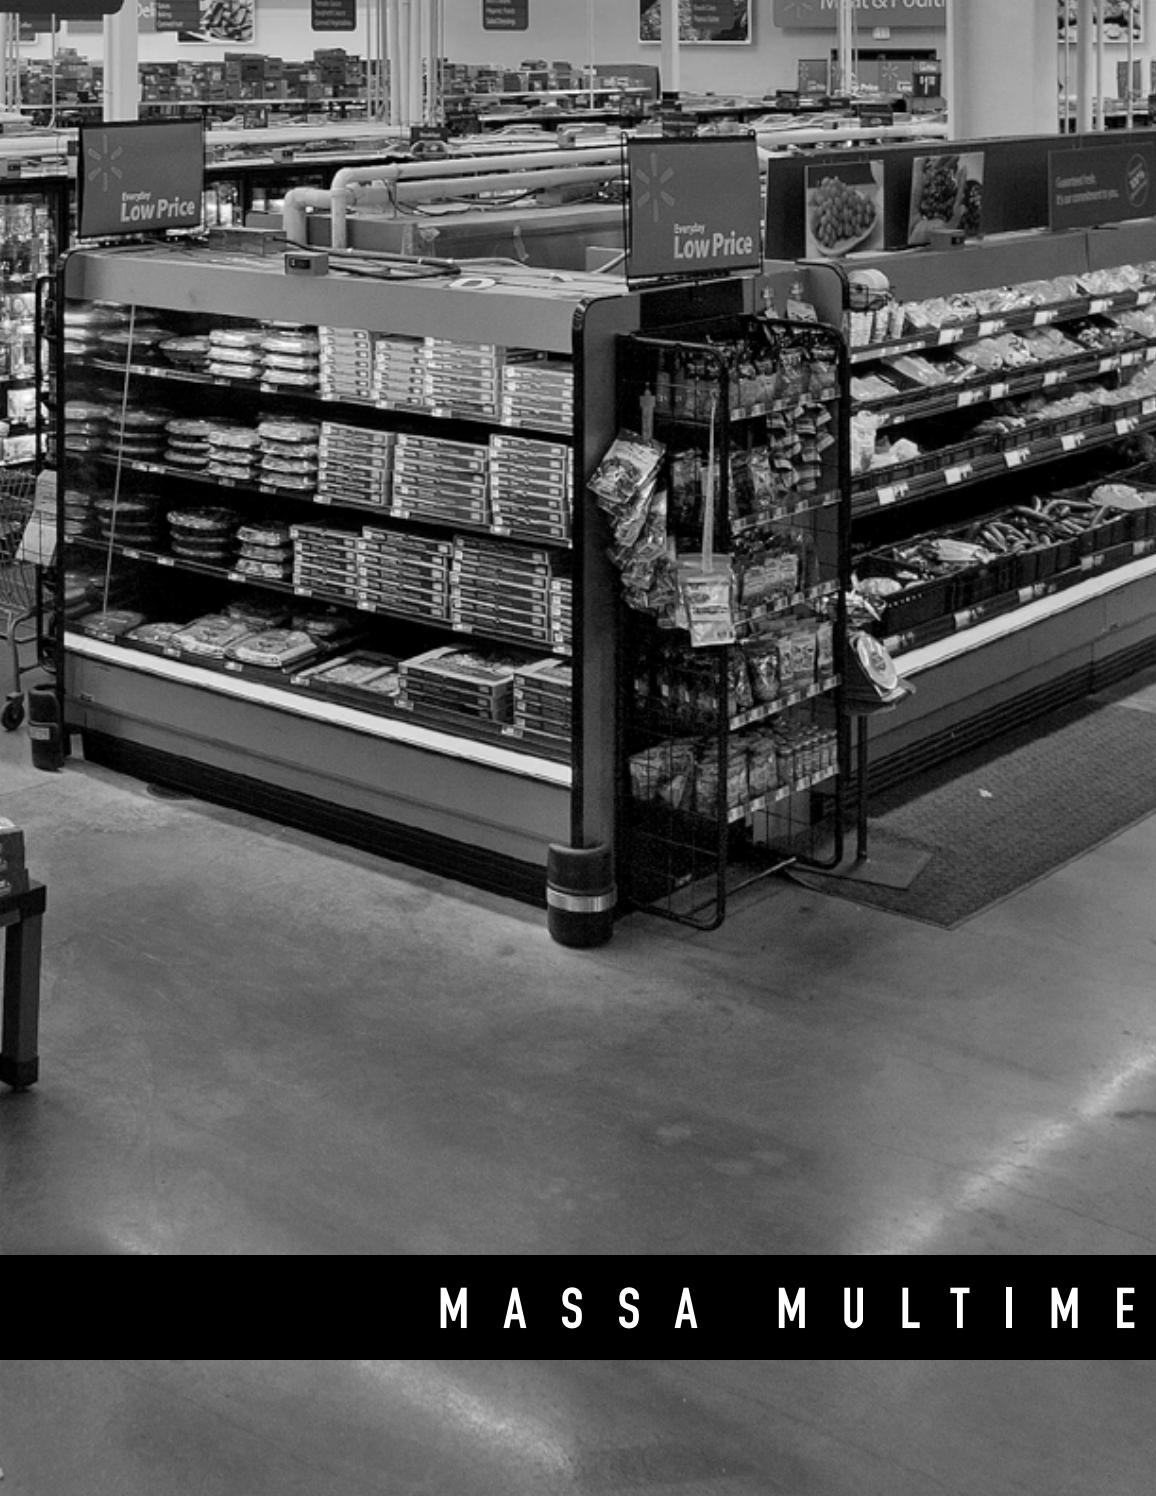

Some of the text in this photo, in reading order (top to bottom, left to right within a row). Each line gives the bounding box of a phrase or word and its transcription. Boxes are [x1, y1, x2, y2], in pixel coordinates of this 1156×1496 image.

[121, 196, 196, 223] Low Price
[674, 230, 752, 259] Low Price
